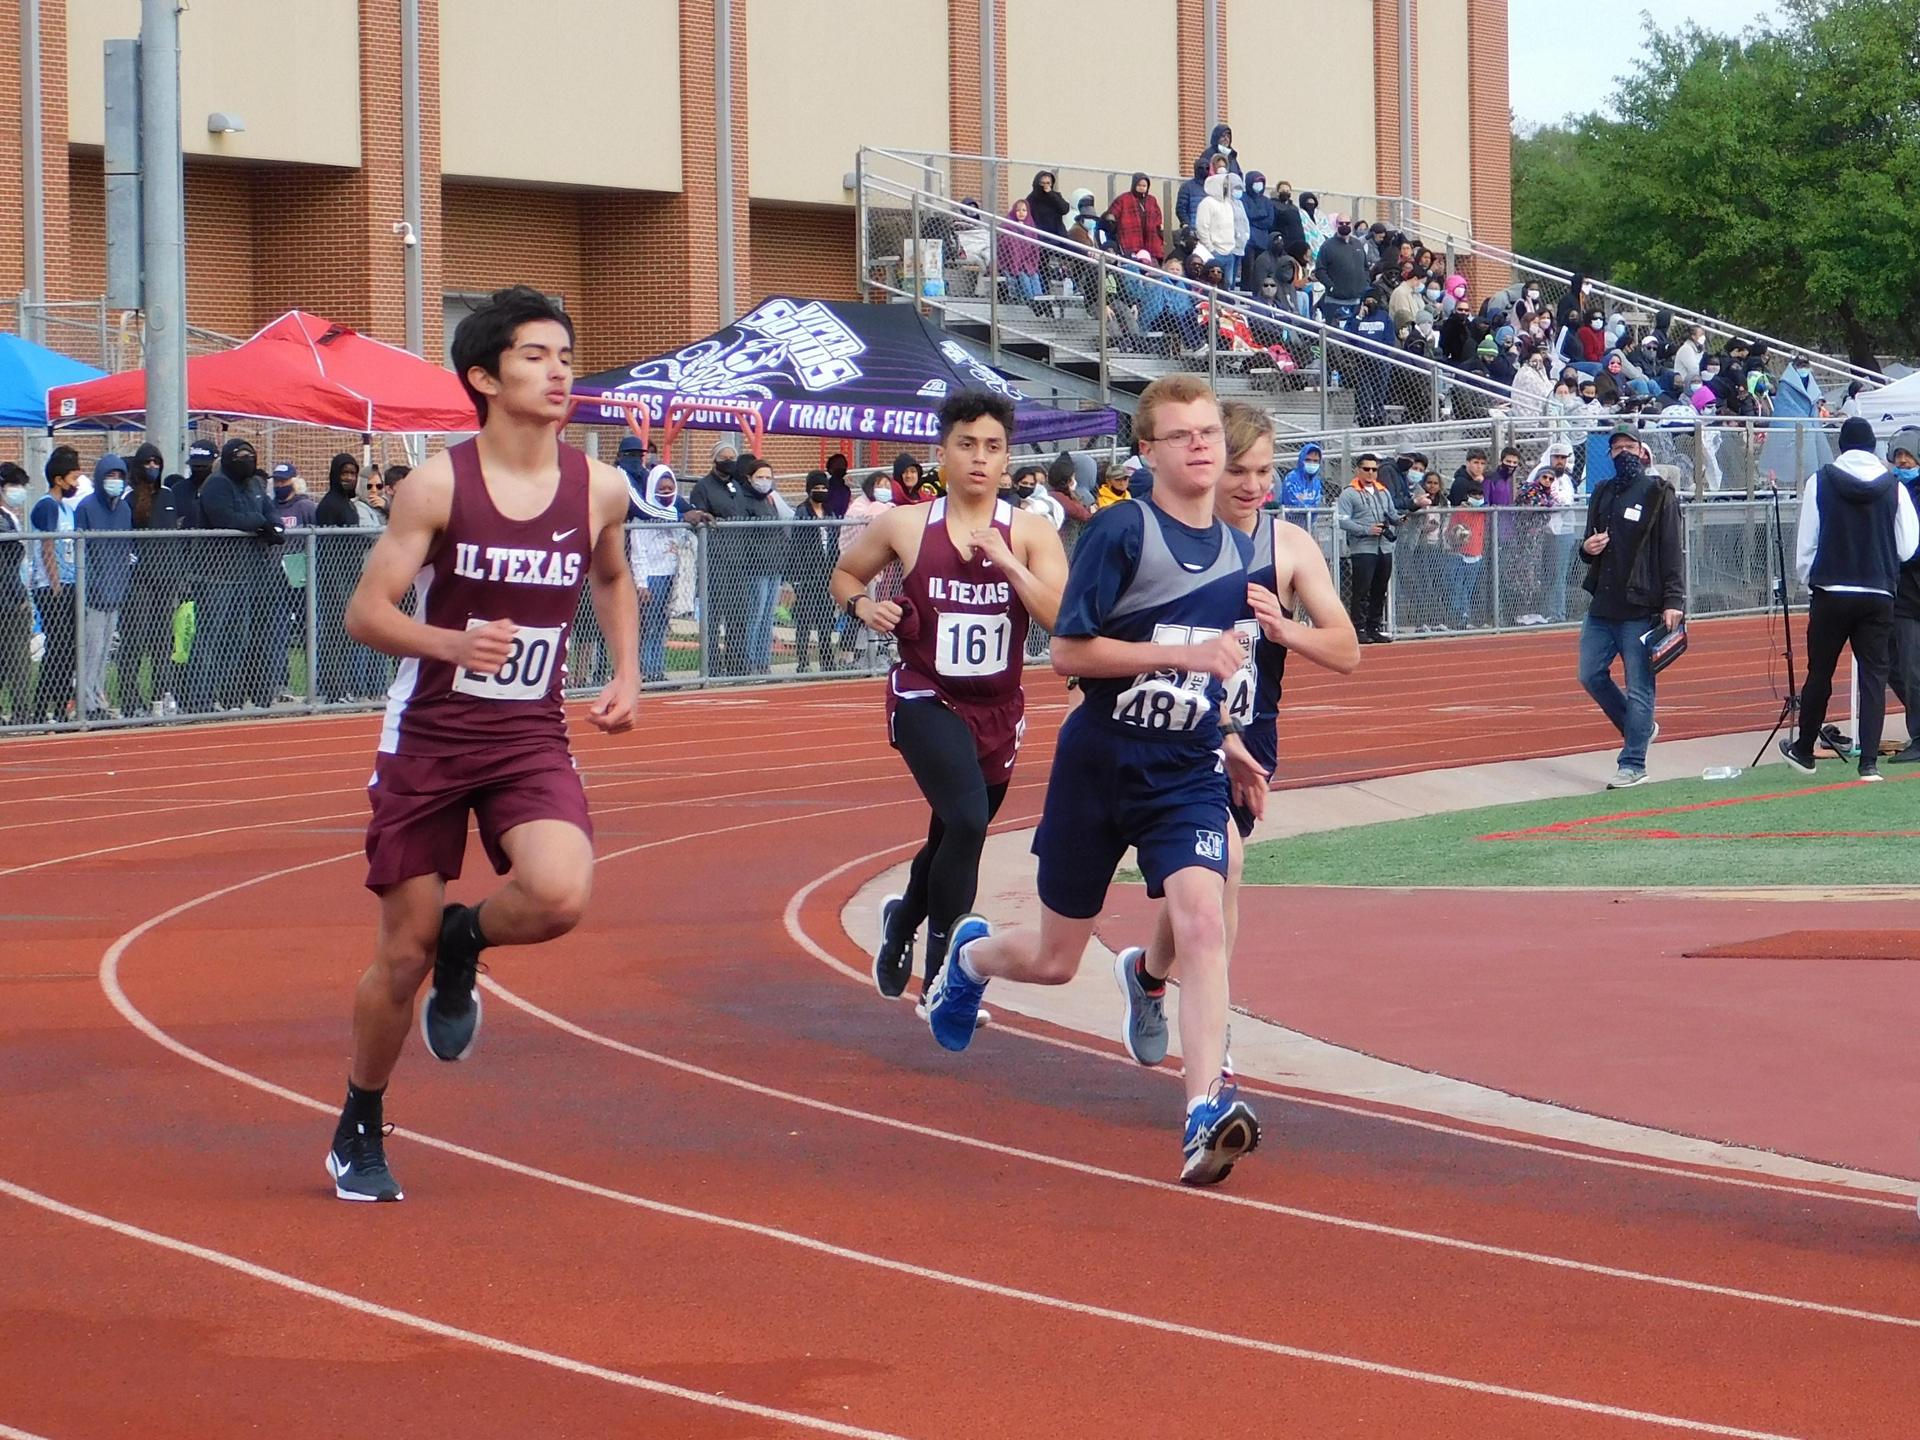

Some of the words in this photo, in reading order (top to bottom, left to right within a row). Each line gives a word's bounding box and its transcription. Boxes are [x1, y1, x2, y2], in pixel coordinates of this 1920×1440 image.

[790, 301, 863, 359] VIPER
[789, 404, 855, 431] TRACK
[860, 408, 876, 432] &
[882, 410, 940, 436] FIELD
[454, 543, 484, 579] IL
[486, 547, 582, 586] TEXAS
[929, 577, 947, 599] IL
[948, 580, 1009, 605] TEXAS
[463, 637, 550, 686] 80
[948, 623, 1005, 665] 161
